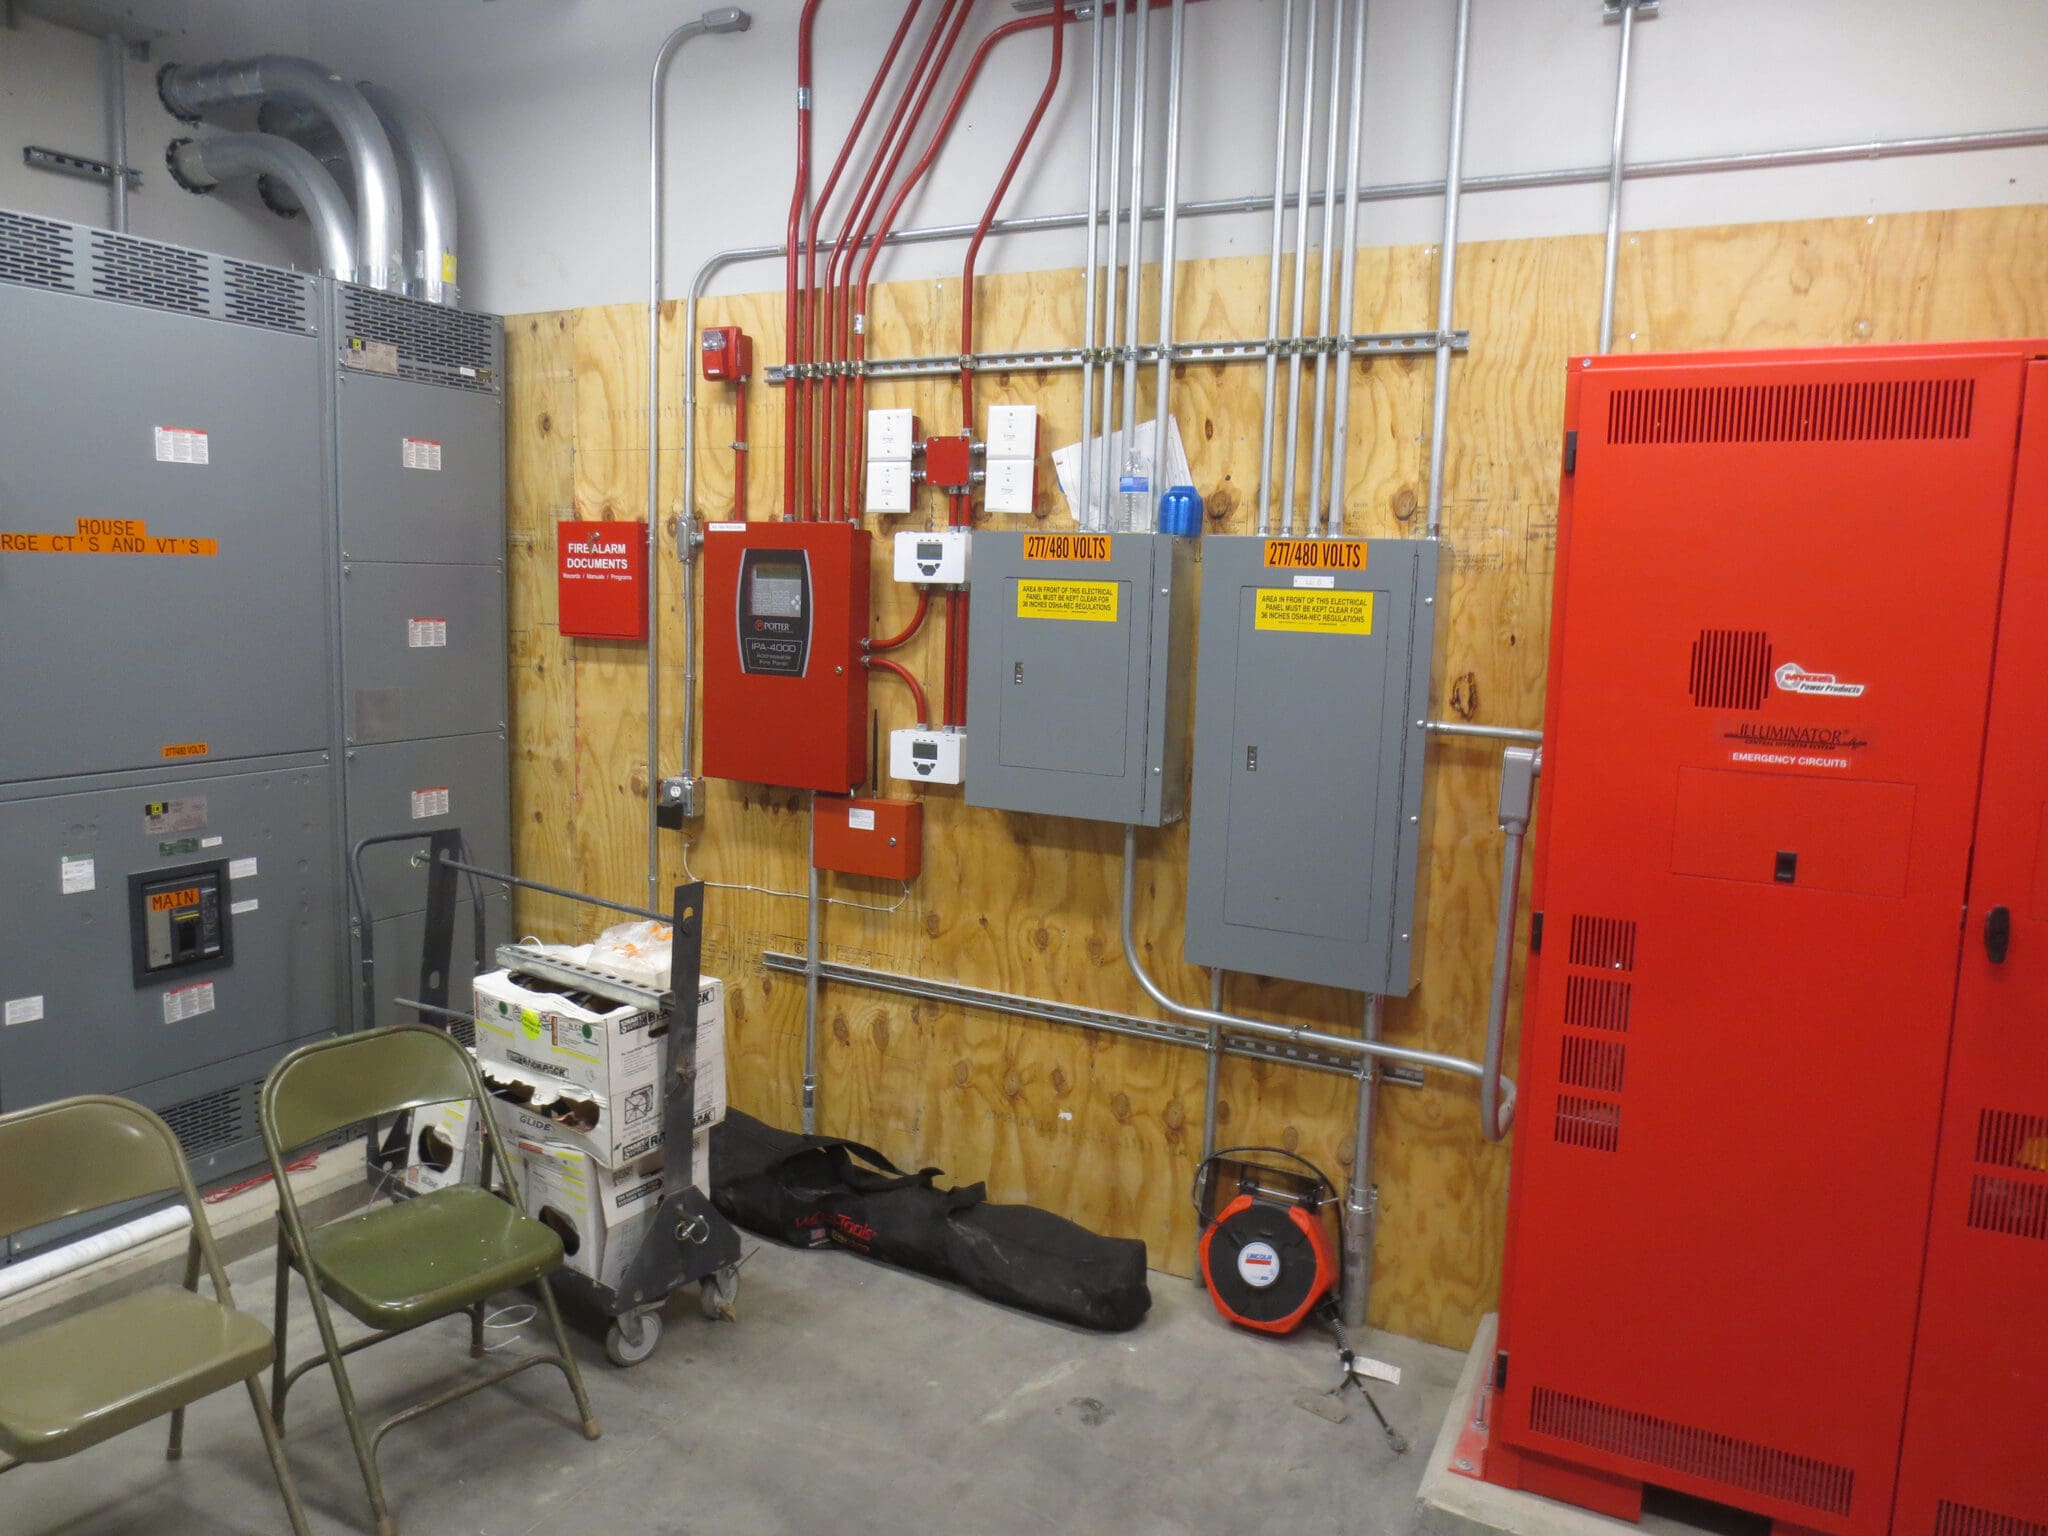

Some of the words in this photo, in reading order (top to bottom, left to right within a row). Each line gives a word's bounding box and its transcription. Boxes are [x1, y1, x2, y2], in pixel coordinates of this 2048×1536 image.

[78, 519, 135, 536] HOUSE
[0, 534, 38, 551] RGE
[52, 536, 99, 552] CT'S
[112, 537, 145, 553] AND
[156, 538, 199, 554] VT'S
[568, 543, 589, 554] FIRE
[591, 543, 626, 554] ALARM
[1028, 536, 1069, 559] 277/480
[1073, 537, 1106, 559] VOLTS
[1269, 542, 1318, 567] 277/480
[1323, 543, 1361, 568] VOLTS
[567, 558, 628, 569] DOCUMENTS
[1081, 588, 1113, 596] ELECTRICAL
[1074, 603, 1111, 611] REGULATIONS
[1285, 596, 1305, 604] FRONT
[1316, 597, 1329, 605] THIS
[1330, 598, 1367, 607] ELECTRICAL
[1285, 604, 1301, 612] MUST
[1328, 606, 1349, 614] CLEAR
[1291, 613, 1321, 621] OSHA-NEC
[1322, 614, 1365, 623] REGULATIONS
[764, 622, 790, 631] POTTER
[1799, 683, 1825, 691] Power
[1825, 684, 1862, 694] Products
[1739, 723, 1842, 744] ILLUMINATOR
[1732, 752, 1796, 764] EMERGENCY
[1798, 757, 1847, 768] CIRCUITS
[152, 890, 195, 911] MAIN
[519, 1114, 551, 1132] GLIDE
